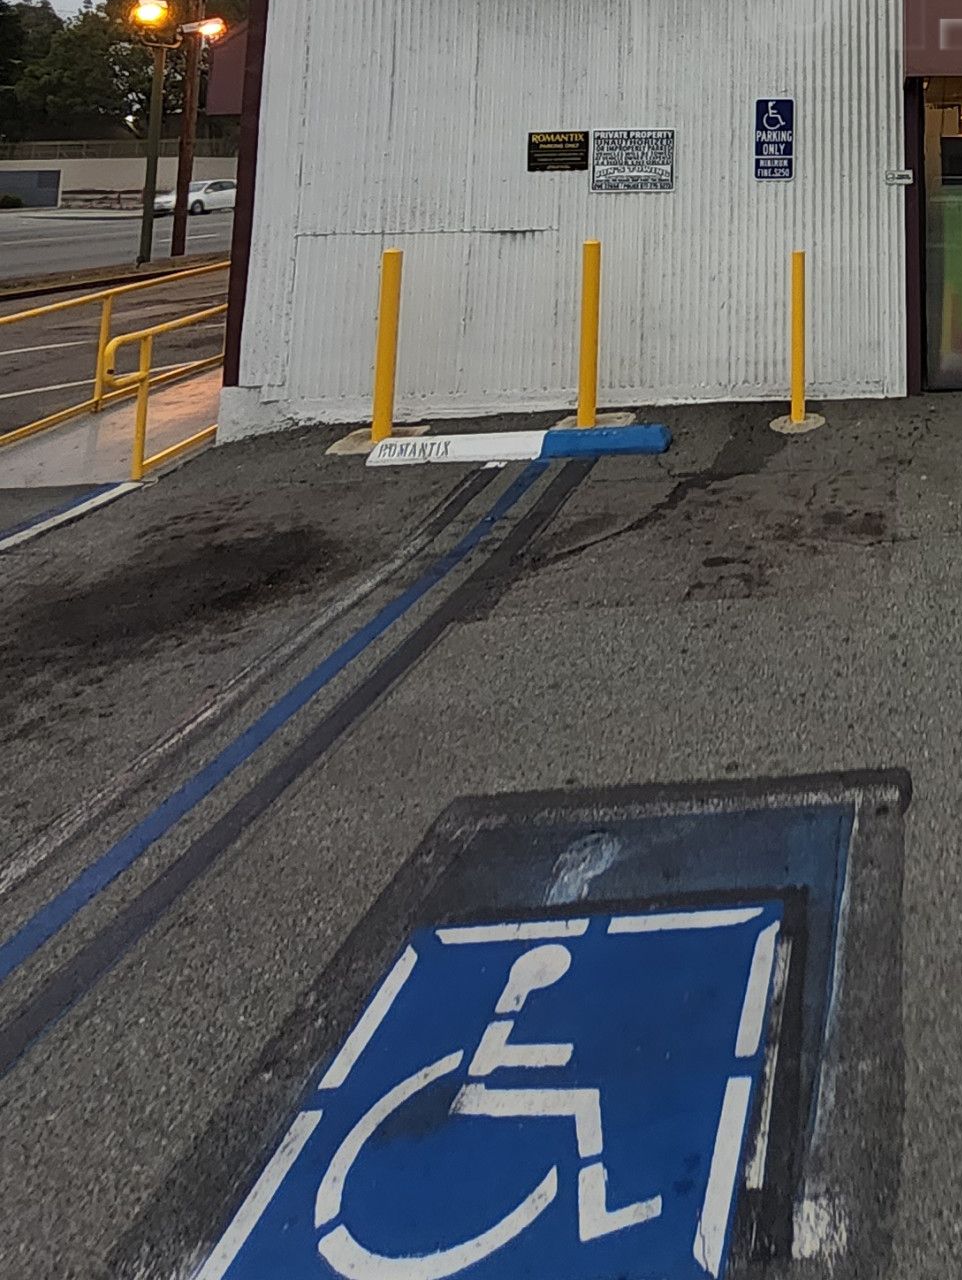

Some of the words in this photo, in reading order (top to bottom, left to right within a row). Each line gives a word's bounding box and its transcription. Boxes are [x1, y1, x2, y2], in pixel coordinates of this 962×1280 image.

[531, 133, 585, 143] ROMANTIX
[756, 130, 793, 142] PARKING
[596, 138, 672, 146] UNAUTHORIZED
[763, 143, 786, 155] ONLY
[757, 168, 772, 177] FINE
[378, 441, 451, 458] ROMANTIX
